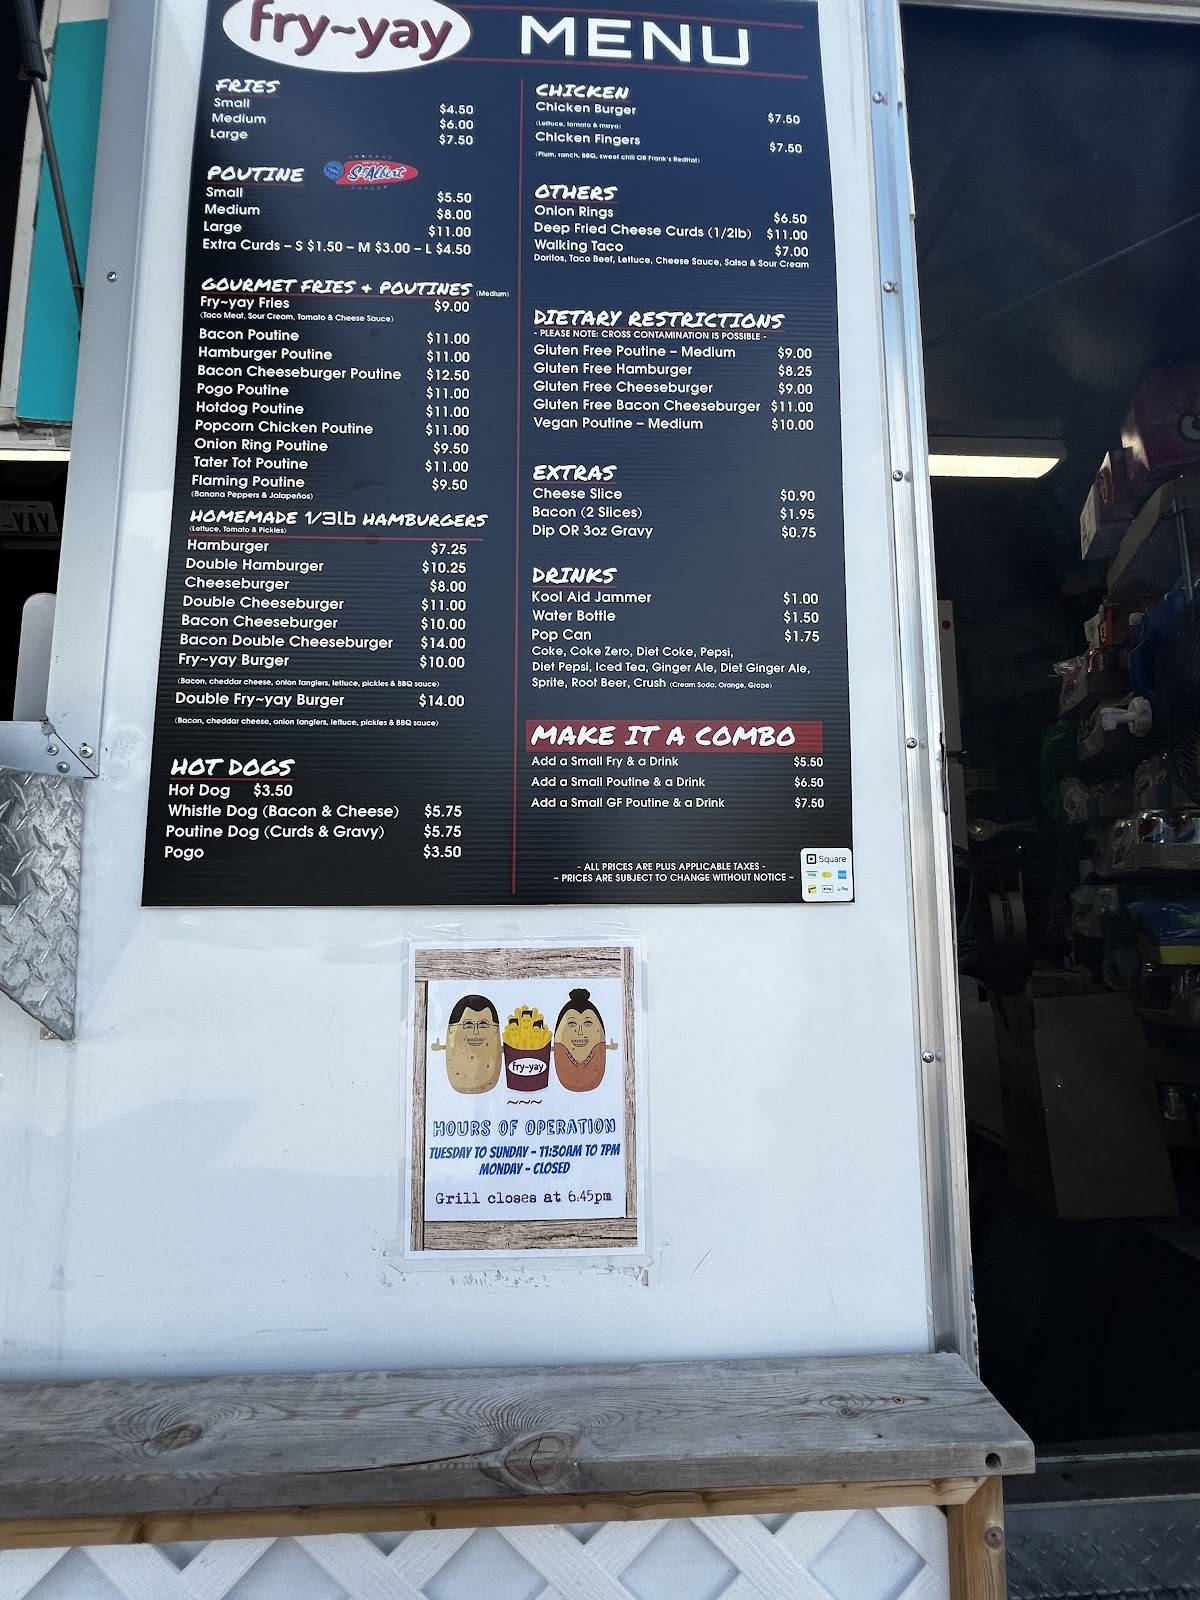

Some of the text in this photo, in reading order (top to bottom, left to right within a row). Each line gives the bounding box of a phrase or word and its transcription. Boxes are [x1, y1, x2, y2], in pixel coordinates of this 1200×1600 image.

[520, 15, 749, 66] MENU
[215, 78, 280, 93] FRIES
[535, 83, 629, 99] CHICKEN
[213, 97, 473, 114] Small $4.50
[535, 101, 800, 124] Chicken Burger $7.50
[211, 113, 473, 129] Medium $6.00
[210, 128, 473, 145] Large $7.50
[535, 131, 802, 153] Chicken Fingers $7.50
[207, 165, 304, 182] POUTINE
[205, 186, 471, 203] Small $5.50
[534, 183, 618, 201] OTHERS
[204, 203, 471, 220] Medium $8.00
[534, 204, 807, 224] Onion Rings $6.50
[203, 220, 471, 237] Large $11.00
[533, 221, 807, 240] Deep Fried Cheese Curds (1/2lb) $11.00
[534, 238, 808, 257] Walking Taco $7.00
[533, 253, 566, 262] Doritos,
[568, 254, 590, 262] Taco
[592, 254, 615, 264] Beef,
[617, 255, 653, 264] Lettuce,
[655, 256, 689, 265] Cheese
[691, 257, 721, 266] Sauce,
[723, 258, 747, 266] Salsa
[758, 259, 777, 267] Sour
[779, 259, 809, 268] Cream
[201, 277, 297, 292] GOURMET
[300, 279, 356, 294] FRIES
[379, 280, 473, 296] POUTINES
[258, 296, 289, 308] Fries
[434, 300, 469, 312] $9.00
[533, 309, 785, 329] DIETARY RESTRICTIONS
[199, 327, 470, 344] Bacon Poutine $11.00
[198, 345, 470, 363] Hamburger Poutine $11.00
[197, 364, 469, 381] Bacon Cheeseburger Poutine $12.50
[533, 361, 812, 377] Gluten Free Hamburger $8.25
[533, 398, 813, 414] Gluten Free Bacon Cheeseburger $11.00
[195, 419, 469, 436] Popcorn Chicken Poutine $11.00
[532, 464, 617, 481] EXTRAS
[191, 474, 467, 491] Flaming Poutine $9.50
[532, 487, 815, 502] Cheese Slice $0.90
[189, 509, 488, 527] HOMEMADE 1/3lb HAMBURGERS
[187, 538, 467, 555] Hamburger $7.25
[532, 567, 617, 584] DRINKS
[531, 590, 818, 605] Kool Aid Jammer $1.00
[180, 633, 465, 651] Bacon Double Cheeseburger $14.00
[531, 645, 733, 658] Coke, Coke Zero, Diet Coke, Pepsi,
[241, 653, 289, 669] Burger
[419, 655, 465, 668] $10.00
[530, 724, 795, 746] MAKE IT A COMBO
[170, 757, 295, 776] HOT DOGS
[168, 783, 292, 799] Hot Dog $3.50
[167, 803, 221, 816] Whistle
[226, 804, 257, 819] Dog
[262, 804, 316, 818] (Bacon
[336, 804, 399, 818] Cheese)
[424, 804, 462, 818] $5.75
[164, 845, 461, 861] Pogo $3.50
[818, 855, 846, 864] Square
[433, 1117, 615, 1137] HOURS OF OPERATION
[429, 1146, 472, 1159] TUESDAY
[474, 1145, 487, 1158] TO
[489, 1145, 529, 1158] SUNDAY
[539, 1144, 582, 1157] 11:30AM
[585, 1143, 598, 1156] TO
[600, 1143, 620, 1156] 7PM
[478, 1162, 523, 1175] MONDAY
[533, 1161, 570, 1174] CLOSED
[435, 1192, 480, 1204] Grill
[487, 1191, 536, 1204] closes
[543, 1190, 561, 1203] at
